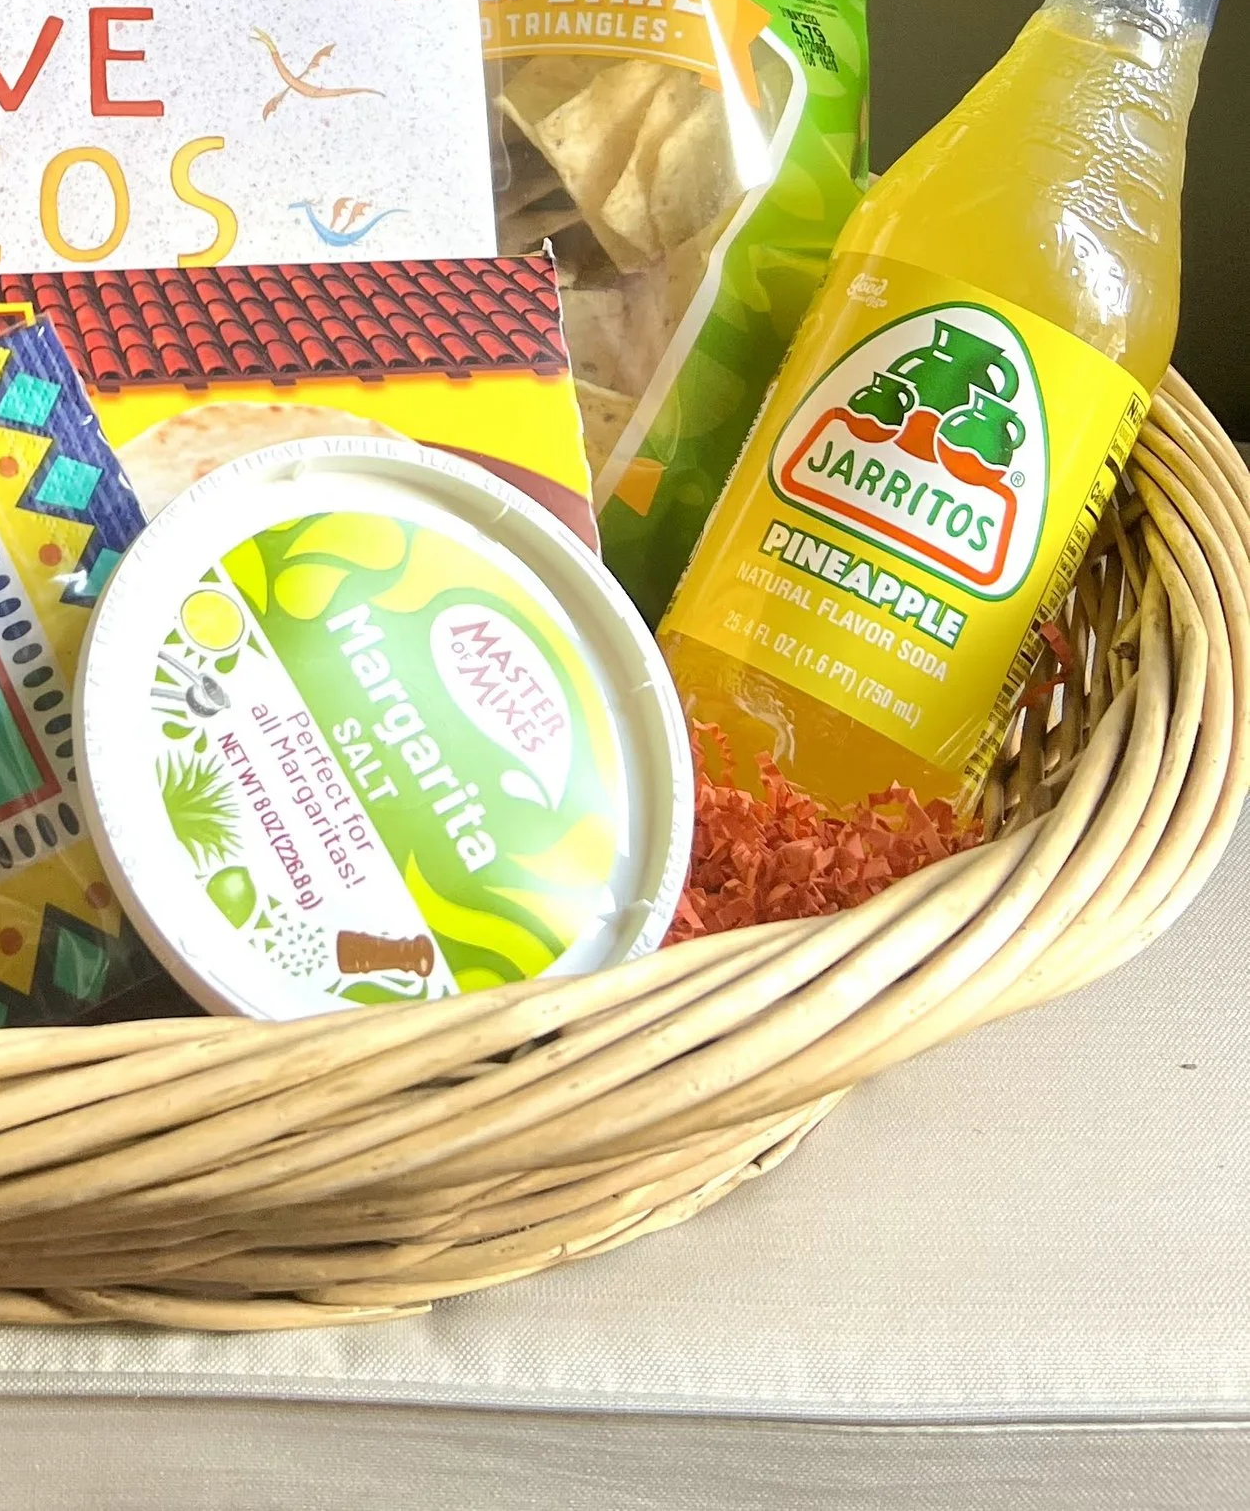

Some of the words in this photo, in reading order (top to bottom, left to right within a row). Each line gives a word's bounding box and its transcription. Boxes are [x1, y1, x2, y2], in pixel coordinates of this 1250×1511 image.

[506, 11, 668, 42] TRIANGLES
[808, 441, 995, 551] JARRITOS
[735, 561, 811, 610] NATURAL
[816, 597, 896, 651] FLAVOR
[897, 640, 949, 682] SODA
[759, 519, 967, 649] PINEAPPLE
[450, 620, 565, 737] MASTER
[451, 642, 472, 662] OF
[723, 610, 752, 636] 25.4
[753, 623, 769, 646] FL
[773, 633, 797, 658] OZ
[795, 644, 829, 673] (1.6
[829, 657, 857, 692] PT)
[856, 675, 893, 707] (750
[218, 732, 250, 766] NET
[326, 603, 496, 873] Margarita
[457, 664, 546, 753] MIXES
[238, 766, 265, 796] WT
[251, 704, 282, 734] all
[270, 736, 366, 889] Margaritas!
[253, 798, 271, 811] 8
[286, 711, 350, 811] Perfect
[343, 813, 374, 850] for
[333, 717, 399, 801] SALT
[261, 811, 285, 837] OZ
